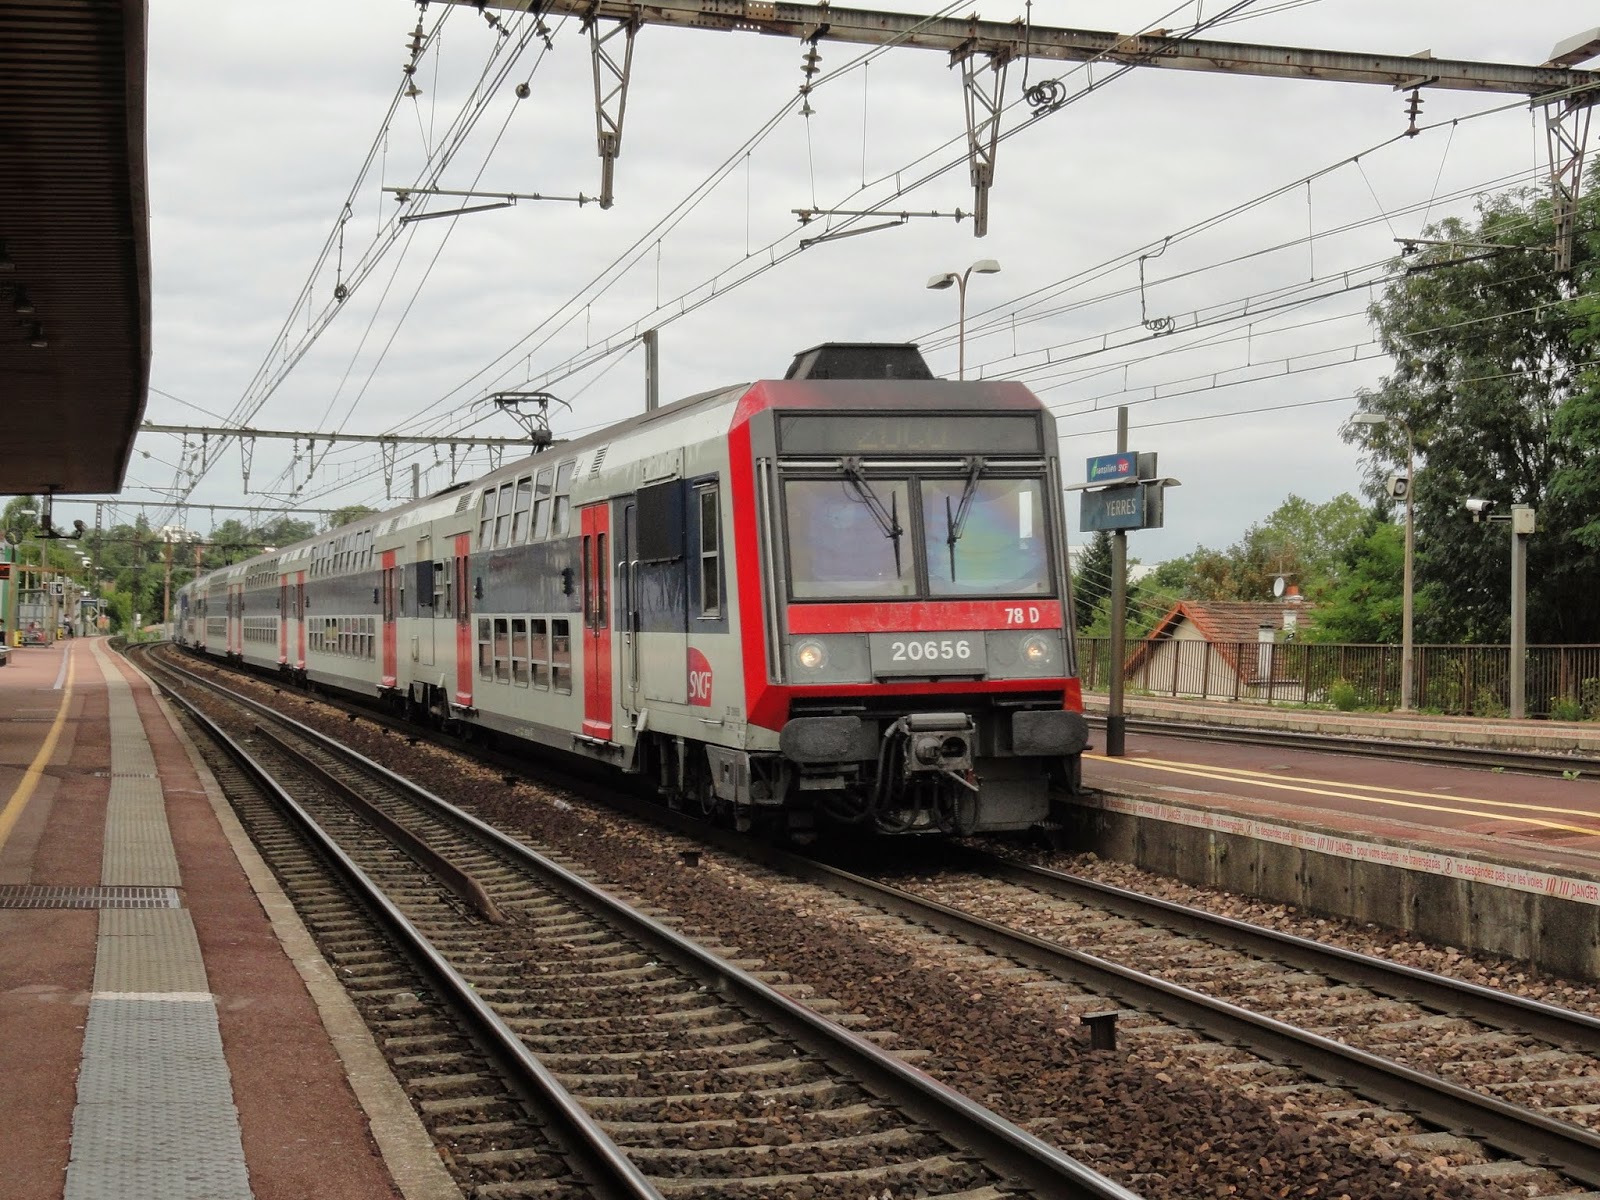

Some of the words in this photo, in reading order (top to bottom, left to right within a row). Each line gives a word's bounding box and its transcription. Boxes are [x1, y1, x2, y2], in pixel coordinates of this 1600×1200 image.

[1106, 498, 1136, 516] YERRES
[1005, 608, 1024, 624] 78
[1029, 607, 1040, 623] D
[892, 640, 971, 661] 20656
[690, 670, 711, 699] SNCF
[1336, 841, 1353, 854] DANGER
[1357, 847, 1369, 858] pour
[1369, 848, 1380, 859] votre
[1457, 864, 1463, 873] ne
[1464, 863, 1494, 879] descendez
[1495, 871, 1506, 883] pas
[1507, 873, 1517, 884] sur
[1518, 872, 1526, 886] les
[1528, 875, 1543, 889] voies
[1571, 883, 1598, 900] DANGER
